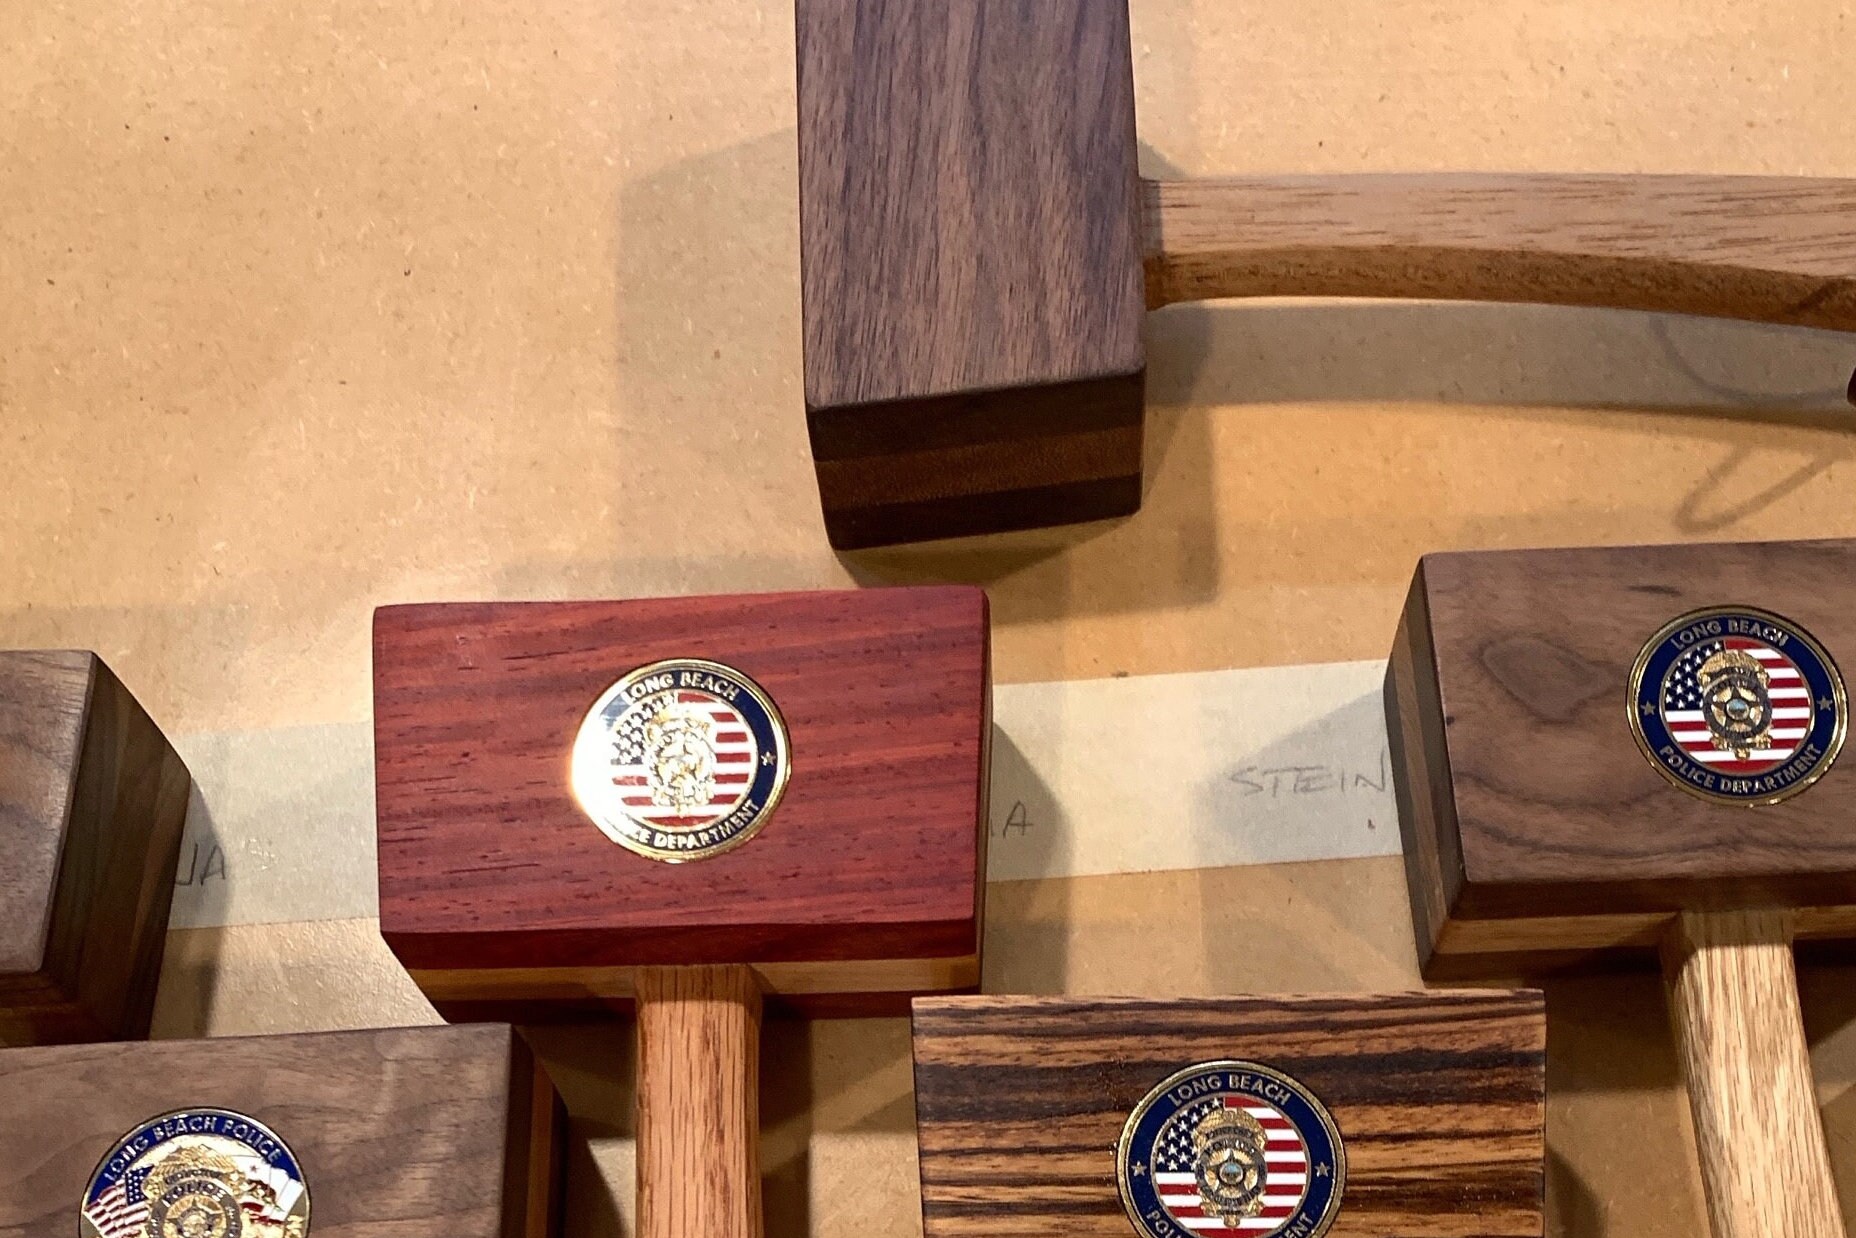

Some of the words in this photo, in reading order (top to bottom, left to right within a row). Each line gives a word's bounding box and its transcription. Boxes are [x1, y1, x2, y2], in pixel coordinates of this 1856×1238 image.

[1670, 620, 1722, 650] LONG
[1727, 619, 1790, 648] BEACH
[622, 672, 675, 704] LONG
[679, 671, 740, 702] BEACH
[1228, 749, 1388, 798] STEIN
[1659, 744, 1716, 789] POLICE
[1719, 742, 1822, 794] DEPARTMENT
[653, 799, 760, 850] DEPARTMENT
[1167, 1074, 1223, 1108] LONG
[1228, 1073, 1292, 1106] BEACH
[103, 1135, 149, 1182] LONG
[152, 1116, 218, 1142] BEACH
[221, 1118, 282, 1164] POLICE
